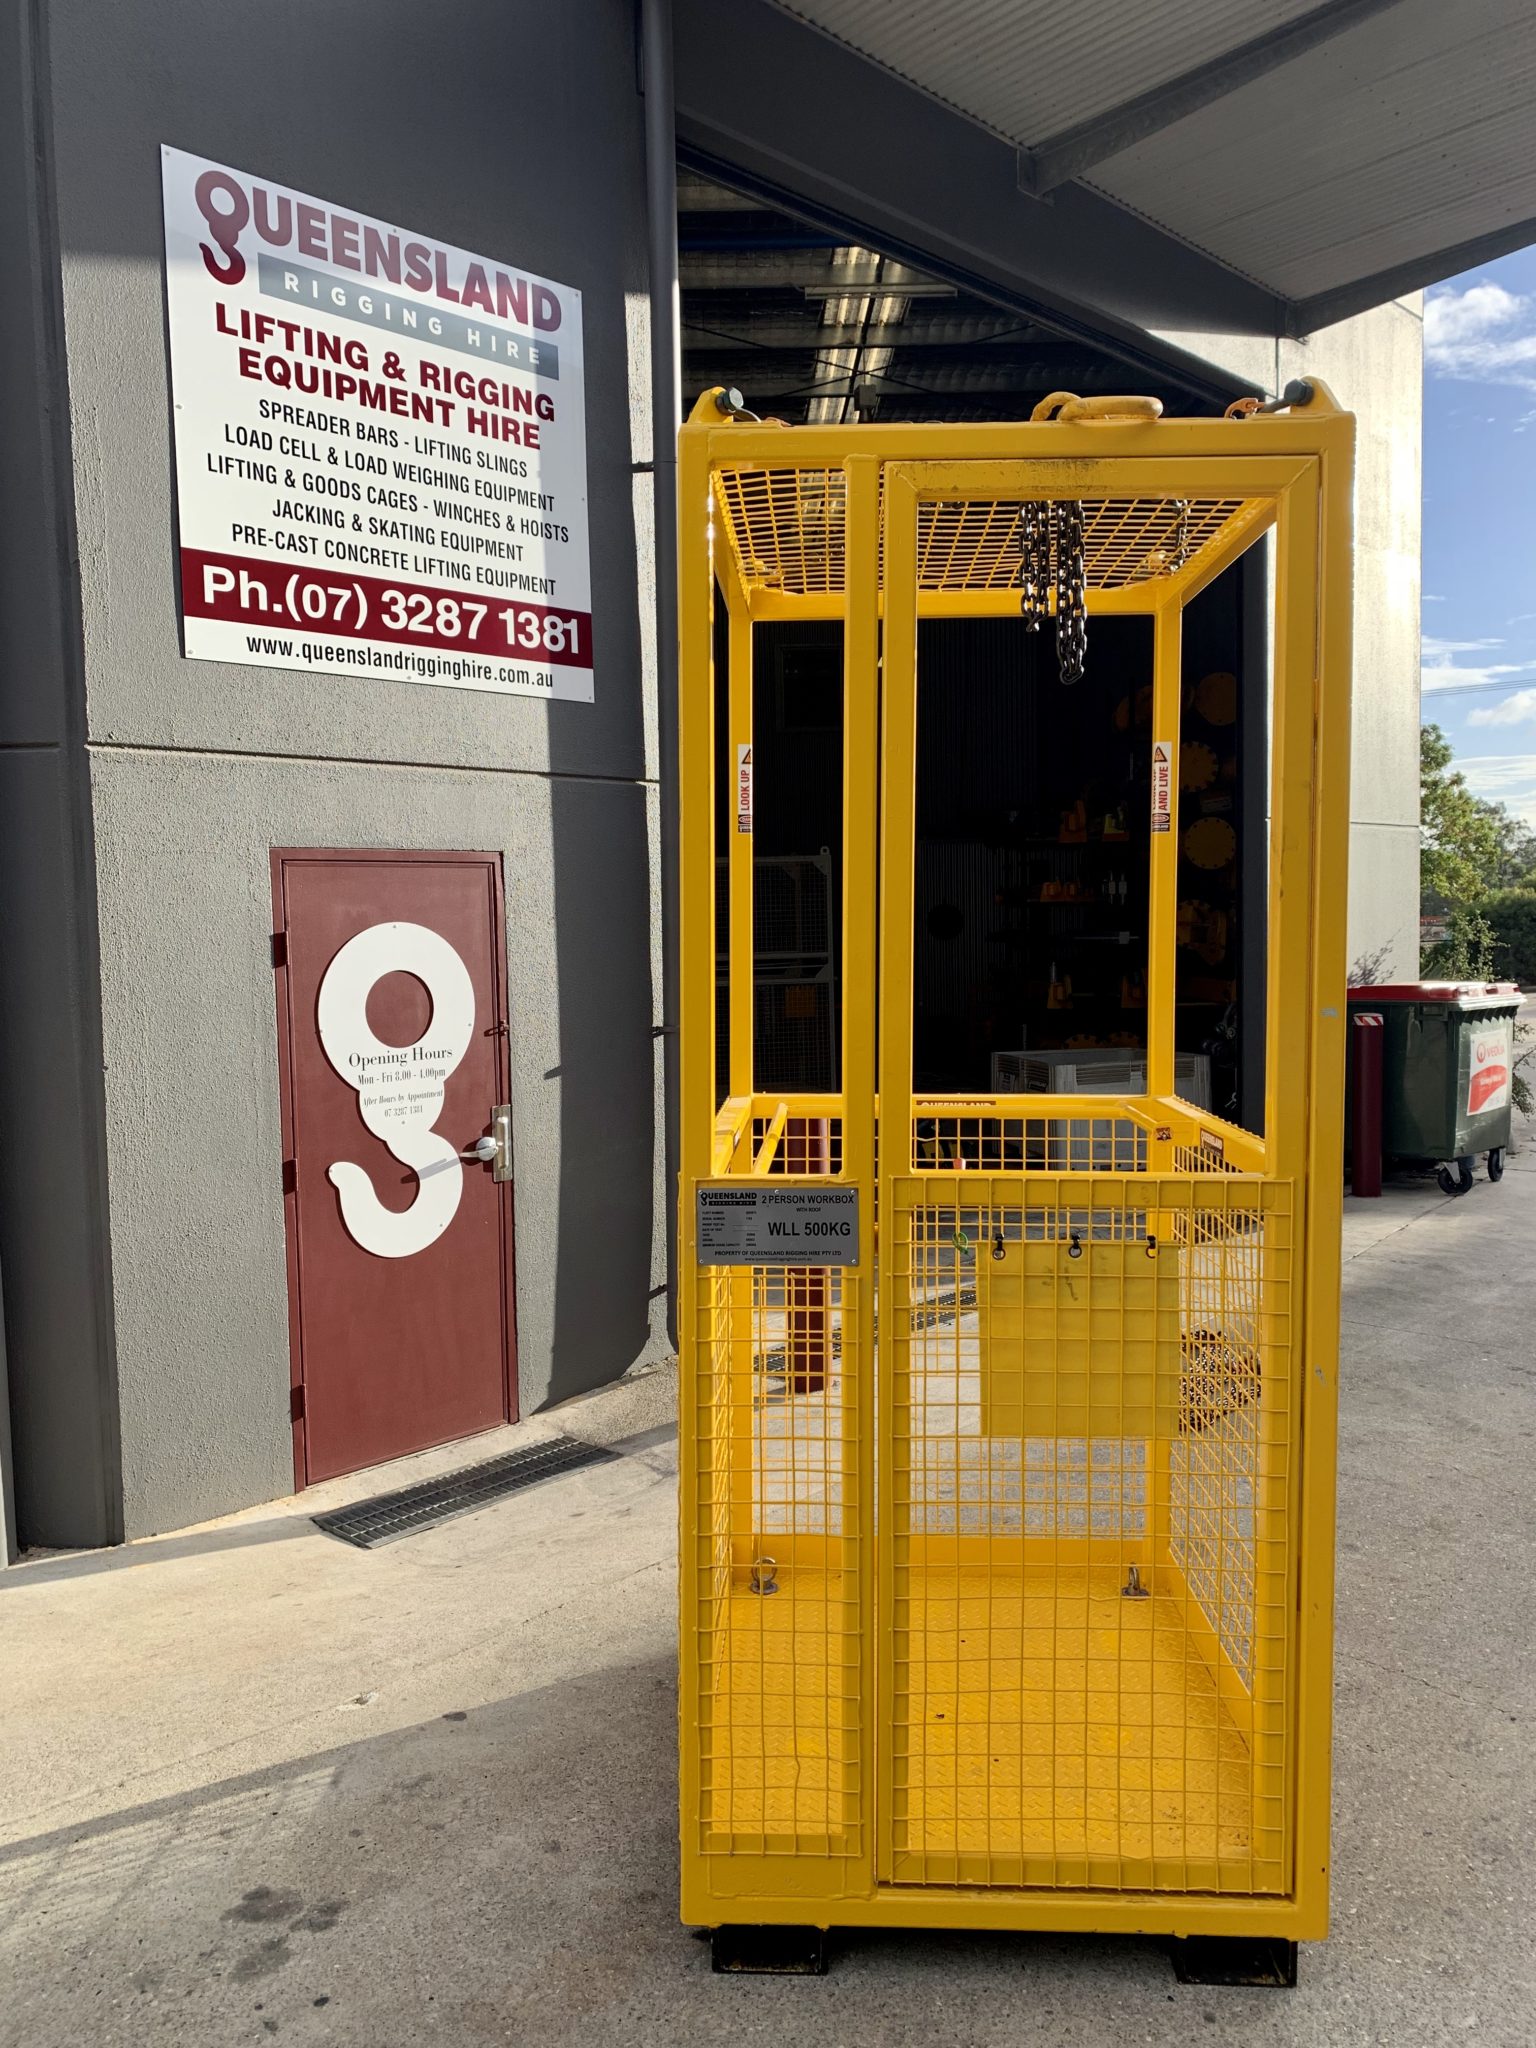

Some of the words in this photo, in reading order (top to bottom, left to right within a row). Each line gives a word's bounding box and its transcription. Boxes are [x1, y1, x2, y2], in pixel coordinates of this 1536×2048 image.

[195, 170, 562, 333] QUEENSLAND
[284, 271, 441, 335] RIGGING
[467, 327, 541, 365] HIRE
[215, 301, 369, 372] LIFTING
[381, 350, 407, 382] &
[419, 359, 556, 422] RIGGING
[238, 346, 455, 428] EQUIPMENT
[466, 406, 541, 451] HIRE
[259, 398, 350, 437] SPREADER
[355, 421, 398, 448] BARS
[414, 435, 471, 465] LIFTING
[476, 450, 527, 478] SLINGS
[224, 423, 273, 451] LOAD
[279, 435, 321, 462] CELL
[326, 446, 338, 466] &
[344, 449, 387, 476] LOAD
[392, 460, 469, 493] WEIGHING
[474, 478, 555, 513] EQUIPMENT
[207, 452, 277, 485] LIFTING
[284, 468, 296, 488] &
[302, 472, 361, 501] GOODS
[366, 485, 418, 512] CAGES
[432, 499, 500, 529] WINCHES
[505, 514, 515, 532] &
[520, 517, 569, 543] HOISTS
[232, 522, 318, 555] PRE-CAST
[324, 539, 409, 571] CONCRETE
[414, 554, 471, 581] LIFTING
[476, 566, 556, 596] EQUIPMENT
[272, 498, 345, 529] JACKING
[351, 513, 362, 532] &
[368, 516, 435, 545] SKATING
[440, 530, 523, 562] EQUIPMENT
[381, 589, 487, 639] 3287
[498, 608, 578, 653] 1381
[245, 636, 554, 688] www.queenslandrigginghire.com.au
[741, 770, 750, 783] UP
[741, 785, 750, 811] LOOK
[1158, 766, 1169, 787] LIVE
[1158, 790, 1168, 811] AND
[349, 1050, 408, 1071] Opening
[412, 1047, 453, 1061] Hours
[358, 1074, 374, 1085] Mon
[381, 1072, 393, 1083] Fri
[700, 1192, 757, 1201] QUEENSLAND
[761, 1195, 767, 1204] 2
[768, 1195, 805, 1204] PERSON
[807, 1195, 854, 1204] WORKBOX
[768, 1222, 800, 1236] WLL
[804, 1222, 851, 1236] 500KG
